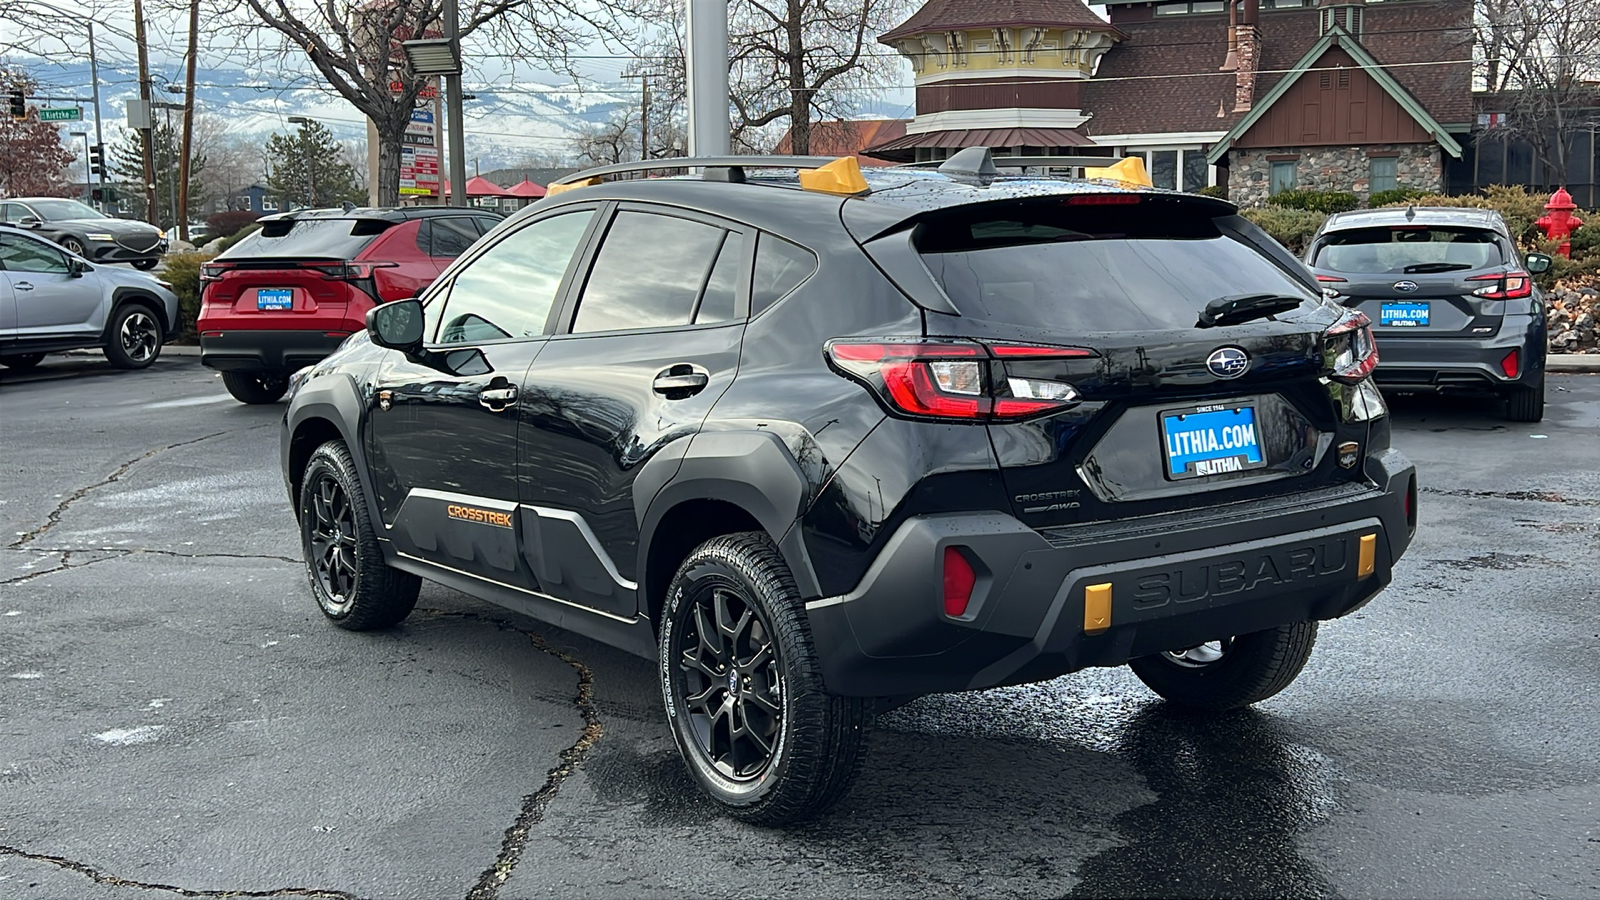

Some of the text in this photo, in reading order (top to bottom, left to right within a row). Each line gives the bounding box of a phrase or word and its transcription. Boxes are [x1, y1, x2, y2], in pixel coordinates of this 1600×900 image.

[46, 111, 69, 119] Kietzke
[258, 296, 291, 304] LITHIA.COM
[1381, 309, 1429, 319] LITHIA.COM
[1196, 404, 1225, 413] SINCE 1946
[1166, 423, 1257, 458] LITHIA.COM
[1205, 456, 1243, 475] LITHIA
[1015, 489, 1081, 503] CROSSTREK
[1046, 502, 1081, 512] AWD
[447, 504, 513, 527] CROSSTREK
[1132, 539, 1348, 611] SUBARU
